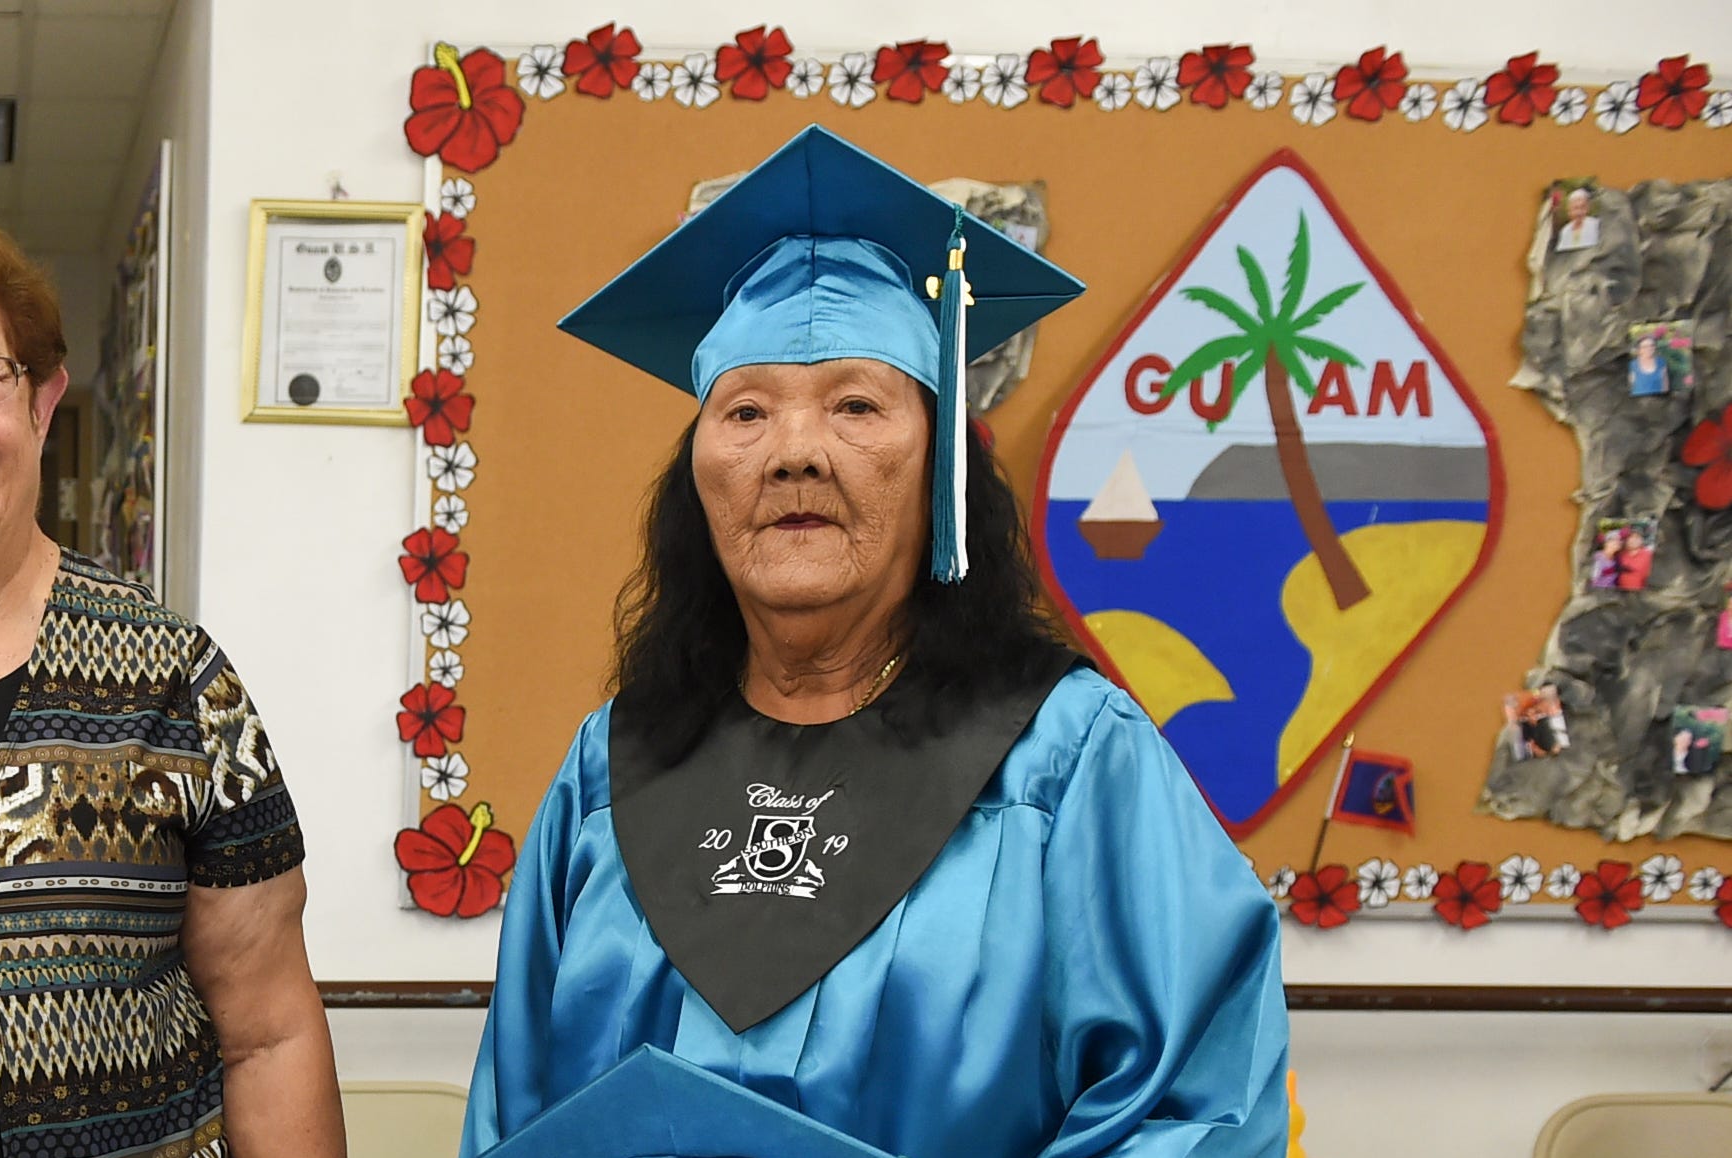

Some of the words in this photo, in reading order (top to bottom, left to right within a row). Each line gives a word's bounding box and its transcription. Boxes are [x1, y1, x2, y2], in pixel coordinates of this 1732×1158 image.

[1125, 354, 1432, 422] GUAM
[746, 783, 805, 808] Class
[801, 789, 835, 815] of
[698, 829, 732, 850] 20
[822, 834, 849, 855] 19
[743, 827, 813, 857] SOUTHERN
[754, 820, 800, 870] S
[740, 881, 792, 895] DOLPHINS
